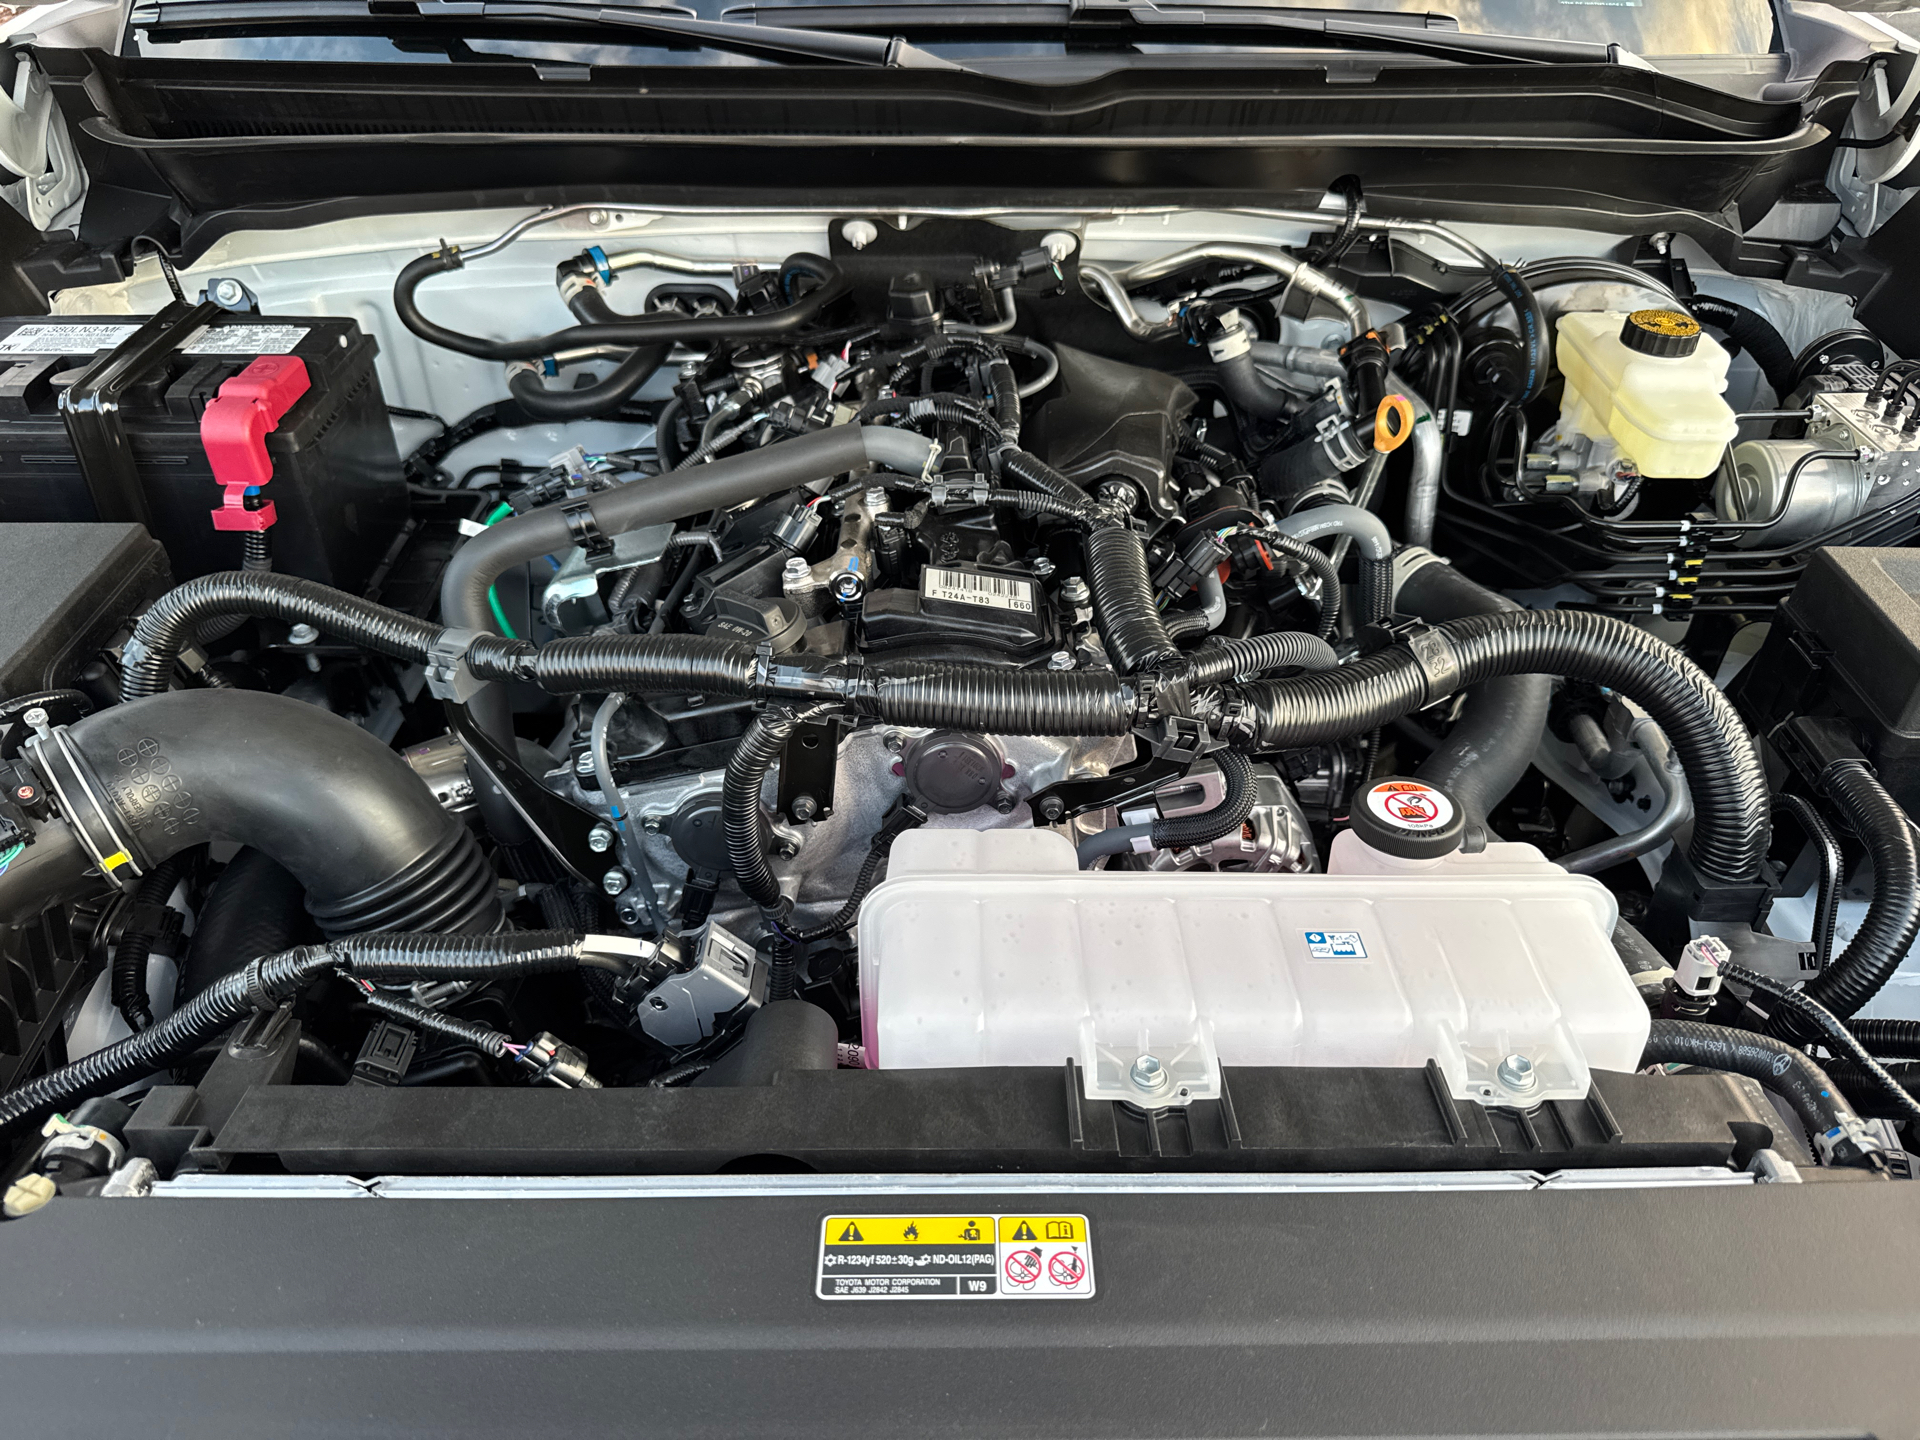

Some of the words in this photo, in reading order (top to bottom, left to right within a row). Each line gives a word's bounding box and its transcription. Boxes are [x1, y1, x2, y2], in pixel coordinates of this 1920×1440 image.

[931, 589, 938, 597] F
[942, 590, 990, 605] T24A-T83
[1013, 602, 1031, 611] 660
[717, 621, 734, 630] SAE
[837, 1254, 875, 1267] R-1234yf
[875, 1254, 914, 1267] 520±30g
[932, 1253, 995, 1266] ND-OIL12(PAG)
[835, 1278, 863, 1286] TOYOTA
[864, 1278, 890, 1286] MOTOR
[891, 1278, 941, 1286] CORPORATION
[968, 1280, 987, 1292] W9
[834, 1286, 849, 1294] SAE
[850, 1286, 867, 1294] J639
